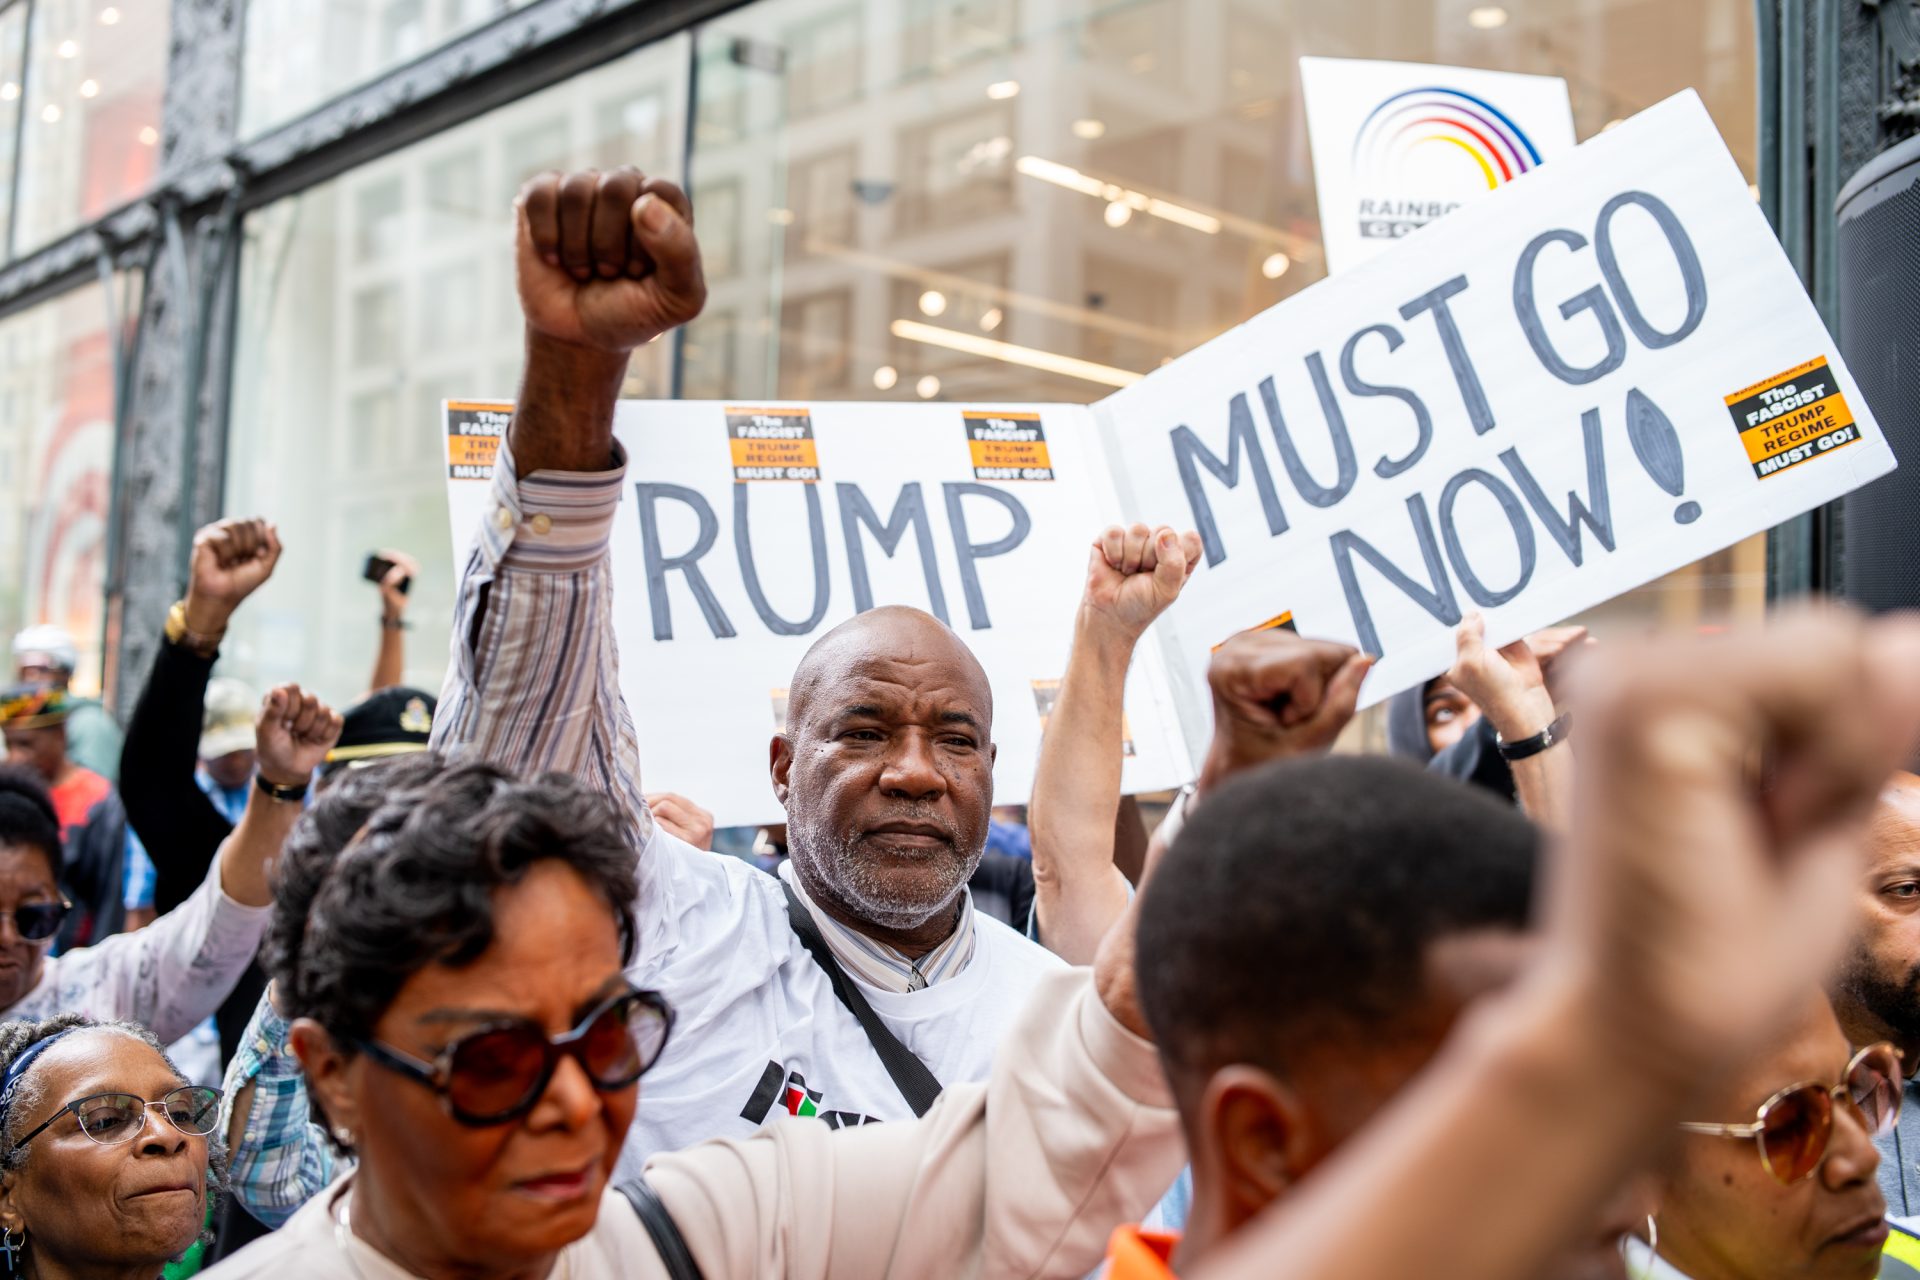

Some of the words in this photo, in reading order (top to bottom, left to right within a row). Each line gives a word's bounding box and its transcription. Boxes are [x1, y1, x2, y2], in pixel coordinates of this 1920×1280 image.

[1169, 273, 1497, 569] MUST
[1512, 189, 1708, 386] GO
[1759, 384, 1797, 406] The
[1745, 383, 1826, 427] FASCIST
[459, 422, 504, 436] FASC
[1760, 404, 1827, 438] TRUMP
[737, 425, 805, 439] FASCIST
[974, 428, 1038, 441] FASCIST
[1763, 415, 1837, 453] REGIME
[468, 440, 499, 449] TRU
[747, 442, 801, 451] TRUMP
[1757, 442, 1813, 476] MUST
[1817, 426, 1855, 451] GO!
[746, 454, 804, 463] REGIME
[737, 466, 784, 479] MUST
[786, 466, 817, 479] GO!
[976, 466, 1020, 479] MUST
[1329, 387, 1702, 664] NOW!
[617, 481, 1032, 641] RUMP
